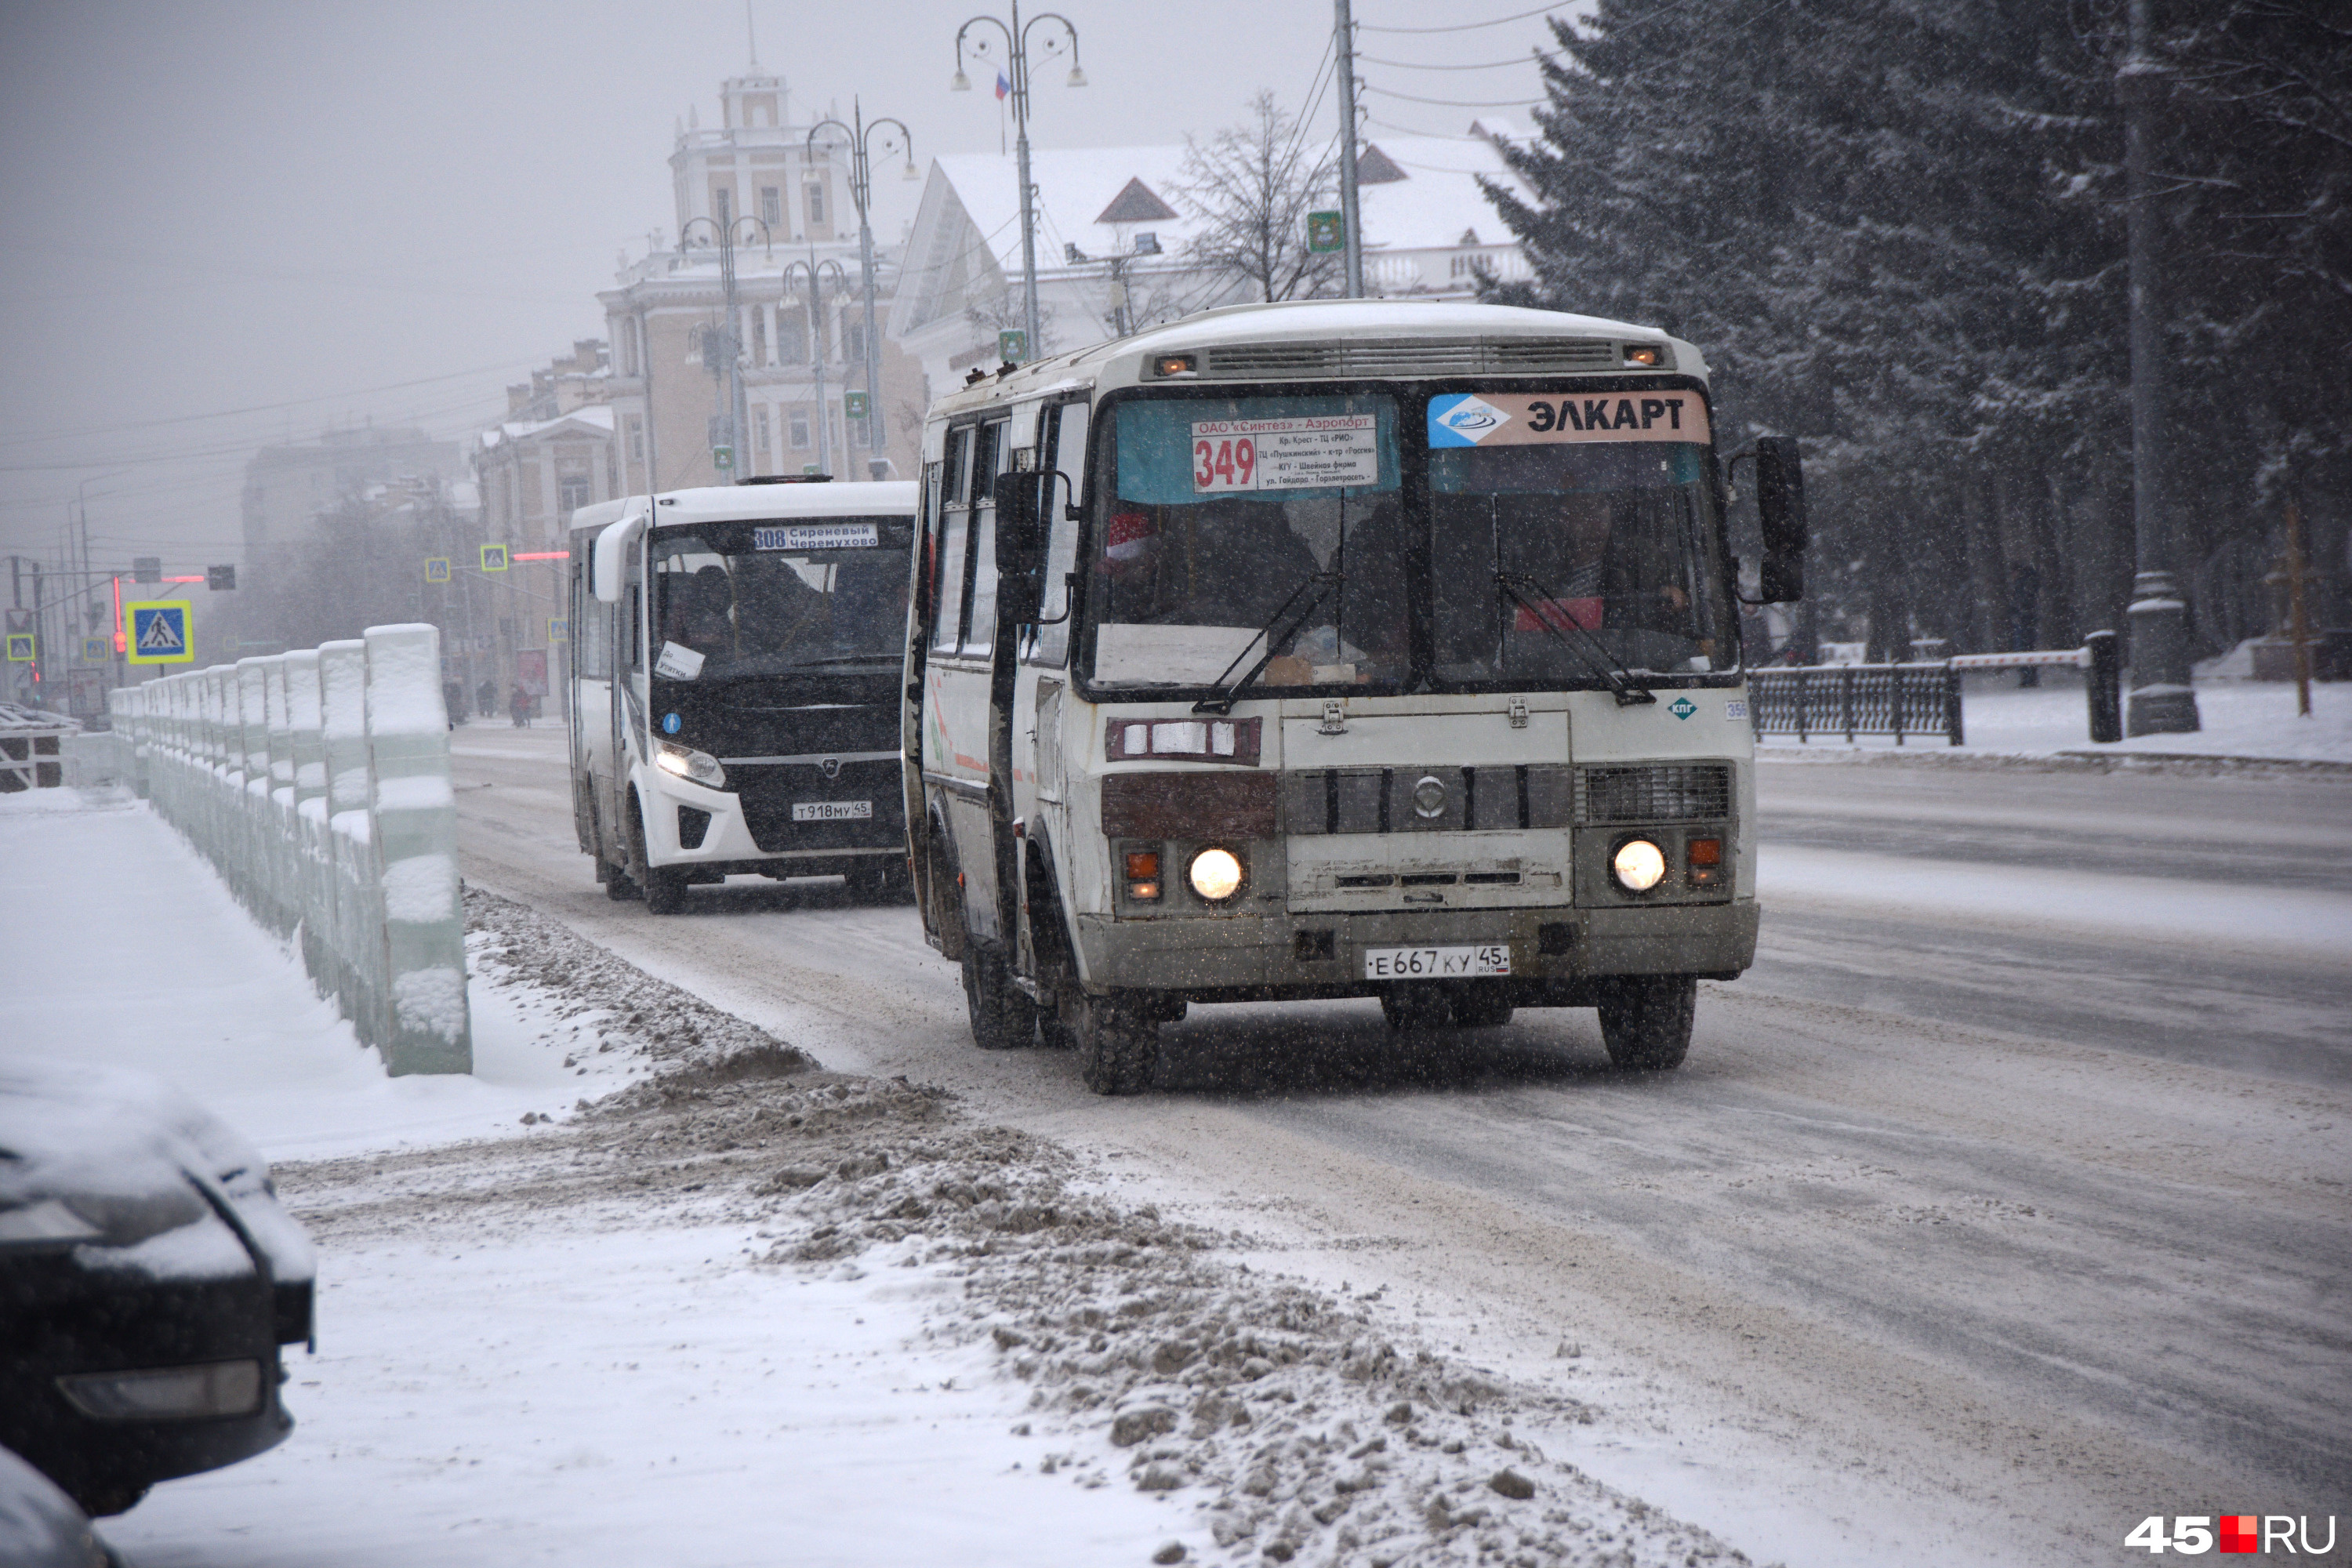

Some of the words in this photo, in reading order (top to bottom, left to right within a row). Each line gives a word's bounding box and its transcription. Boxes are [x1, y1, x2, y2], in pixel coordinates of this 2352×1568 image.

[1527, 398, 1684, 432] ЭЛКАРТ
[1199, 423, 1229, 434] ОАО
[1232, 420, 1294, 433] «Синтез»
[1305, 417, 1369, 430] Аэропорт
[1279, 437, 1291, 446] Кр.
[1293, 436, 1312, 445] Крест
[1319, 435, 1329, 444] ТЦ
[1331, 434, 1354, 442] «РИО»
[1270, 448, 1321, 460] «Пушкинский»
[1345, 447, 1375, 456] «Россия»
[1195, 437, 1254, 488] 349
[1299, 461, 1331, 470] Швейная
[1333, 461, 1356, 470] фирма
[1279, 477, 1308, 485] Гайдара
[754, 529, 786, 548] 308
[789, 526, 869, 539] Сиреневый
[789, 538, 877, 550] Черемухово
[1671, 704, 1693, 713] КПГ
[798, 804, 851, 818] Т918МУ
[854, 803, 867, 812] 45
[1479, 947, 1502, 966] 45
